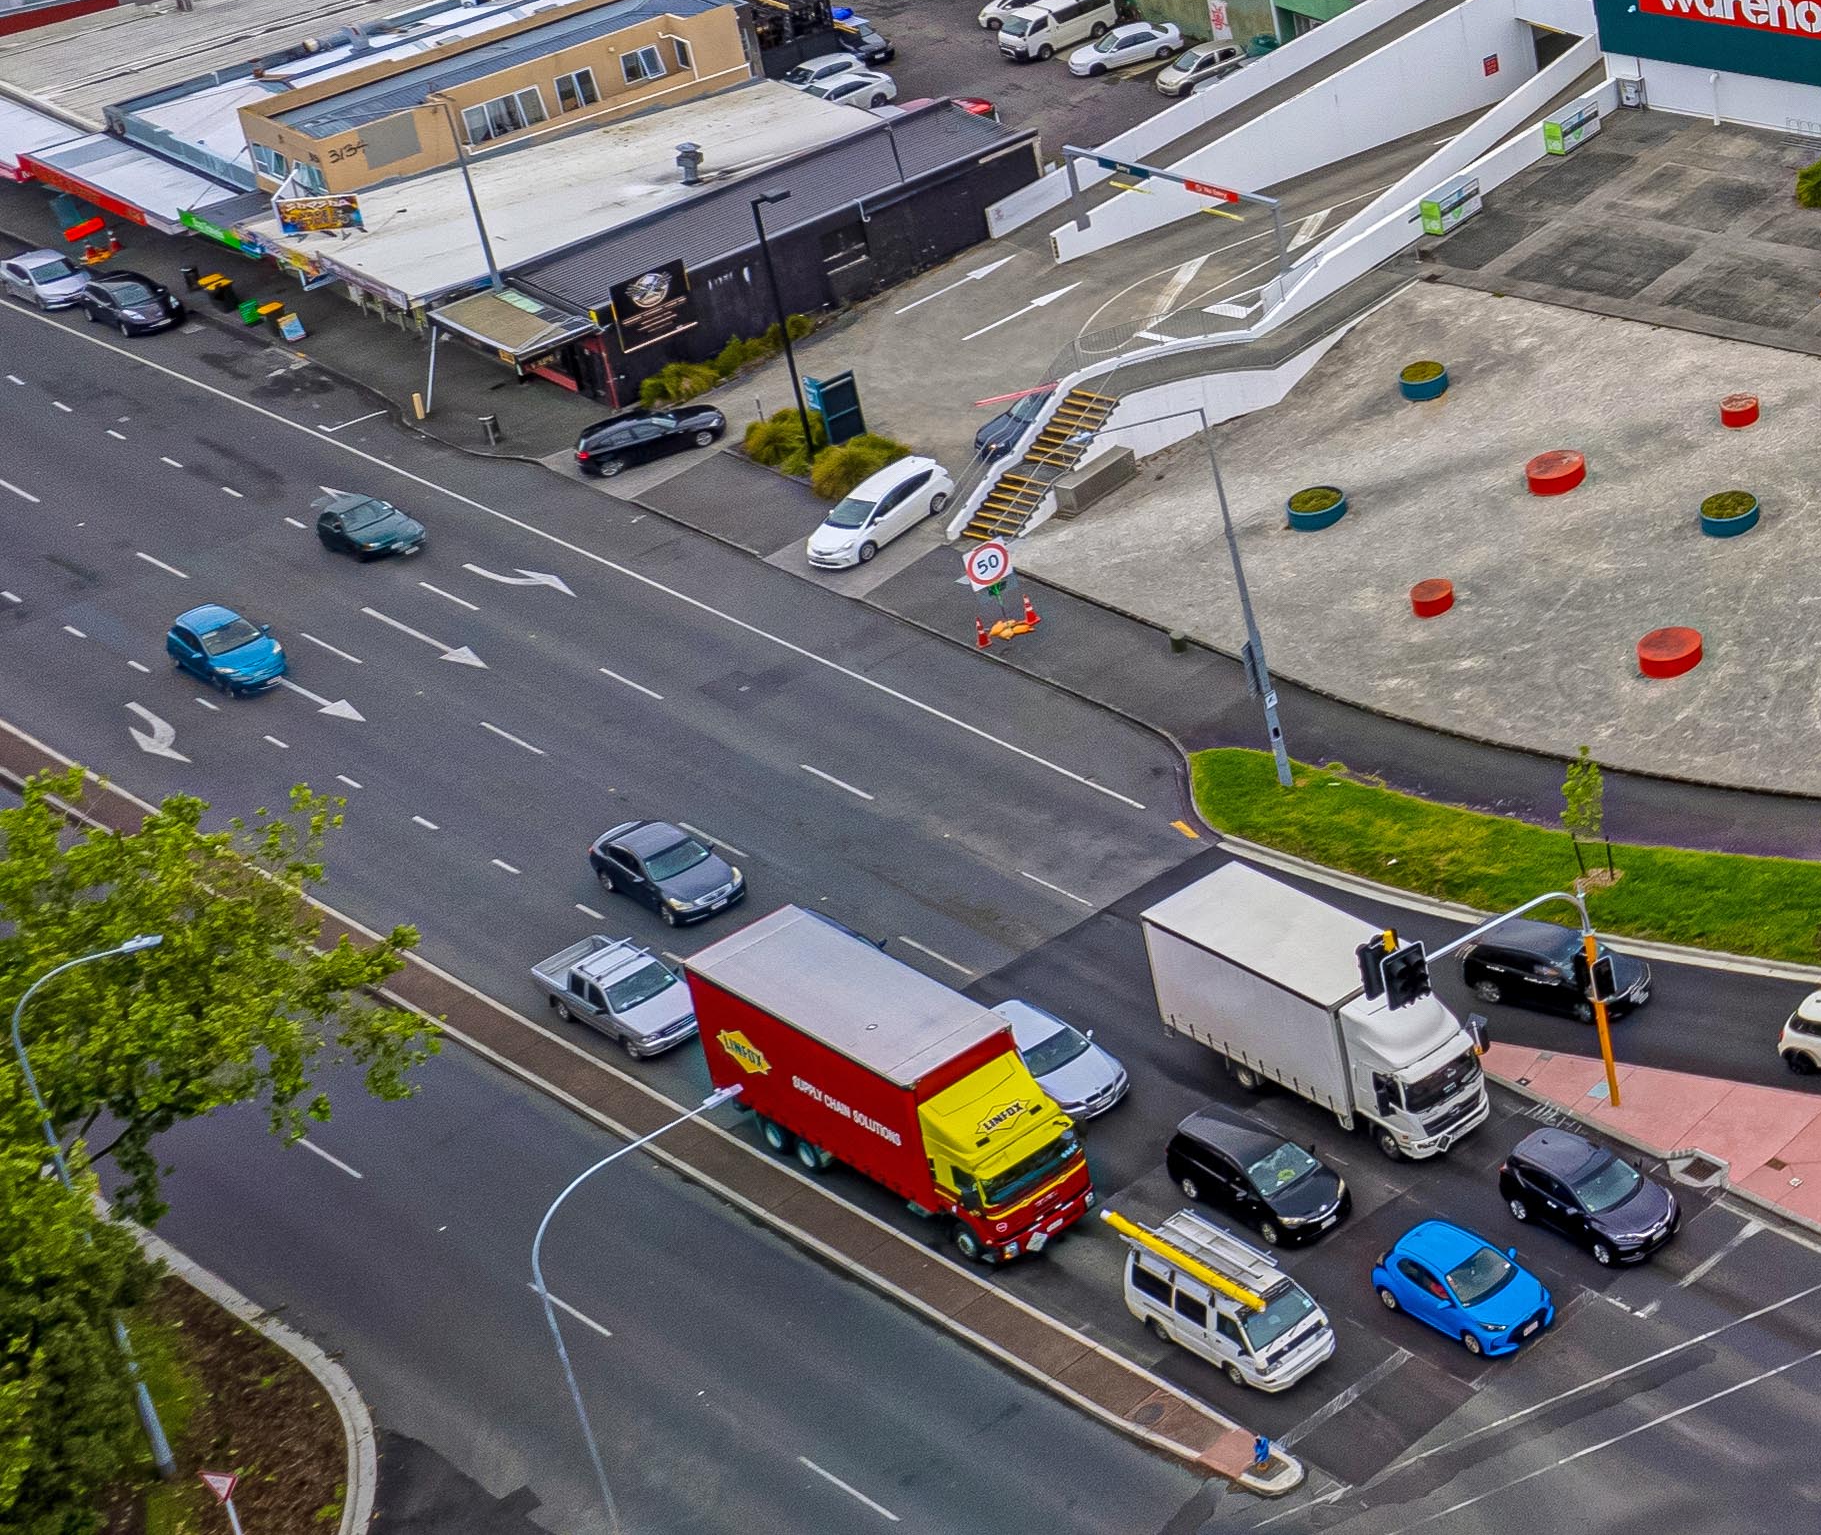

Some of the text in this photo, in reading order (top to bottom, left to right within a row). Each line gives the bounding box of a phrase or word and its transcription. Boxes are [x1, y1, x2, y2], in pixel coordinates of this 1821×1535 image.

[977, 554, 999, 575] 50
[723, 1034, 763, 1069] LINFOX
[792, 1075, 902, 1147] SUPPLY CHAIN SOLUTIONS
[983, 1102, 1023, 1131] LINFOX
